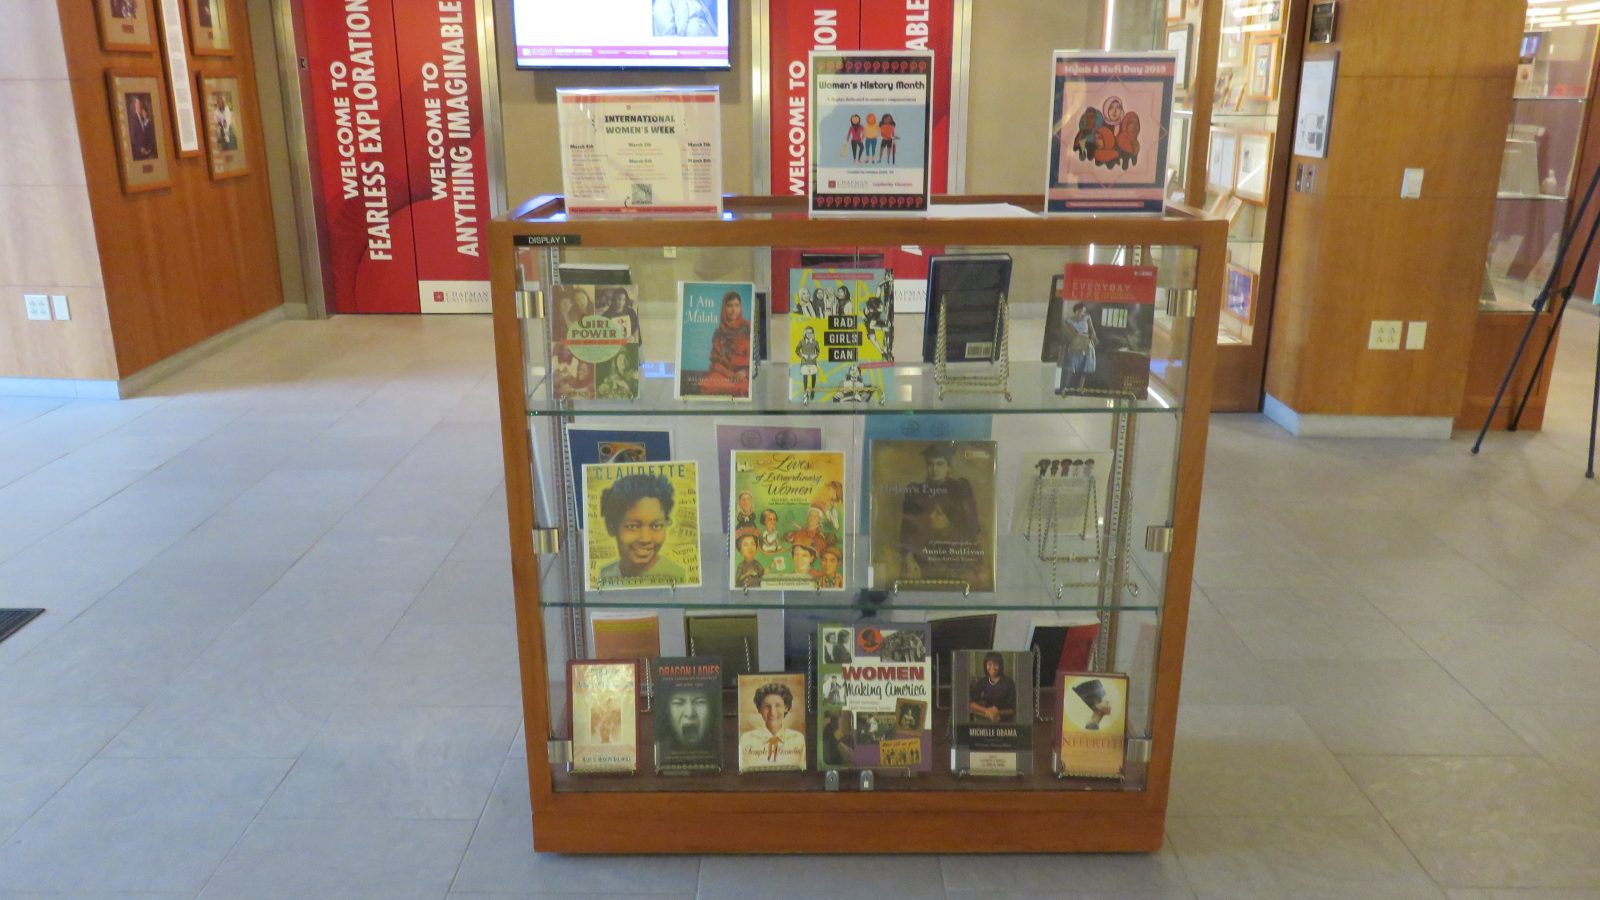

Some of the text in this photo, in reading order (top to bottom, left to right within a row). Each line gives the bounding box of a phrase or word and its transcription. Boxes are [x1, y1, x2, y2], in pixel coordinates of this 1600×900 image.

[1065, 64, 1091, 75] Hijab
[1123, 65, 1144, 75] Day
[819, 81, 925, 91] Women's History Month
[604, 115, 675, 123] INTERNATIONAL
[330, 61, 359, 200] WELCOME TO
[345, 0, 393, 261] FEARLESS EXPLORATION
[421, 62, 448, 200] WELCOME TO
[439, 0, 479, 257] ANYTHING IMAGINABLE
[605, 126, 675, 134] WOMEN'S WEEK
[788, 60, 806, 196] WELCOME TO
[1072, 281, 1131, 292] EVERYDAY
[689, 295, 714, 308] I Am
[687, 310, 719, 324] Malala
[833, 318, 854, 328] RAD
[578, 319, 609, 328] GIRL
[572, 329, 617, 338] POWER
[829, 334, 859, 344] GIRLS
[833, 350, 854, 360] CAN
[769, 454, 811, 473] Lives
[595, 465, 686, 480] CLAUDETTE
[752, 471, 822, 487] of Extraordinary
[767, 483, 814, 496] Women
[949, 547, 985, 556] Sullivan
[659, 664, 720, 676] DRAGON LADIES
[841, 666, 925, 681] WOMEN
[846, 680, 927, 700] Making America
[968, 728, 1018, 737] MICHELLE OBAMA
